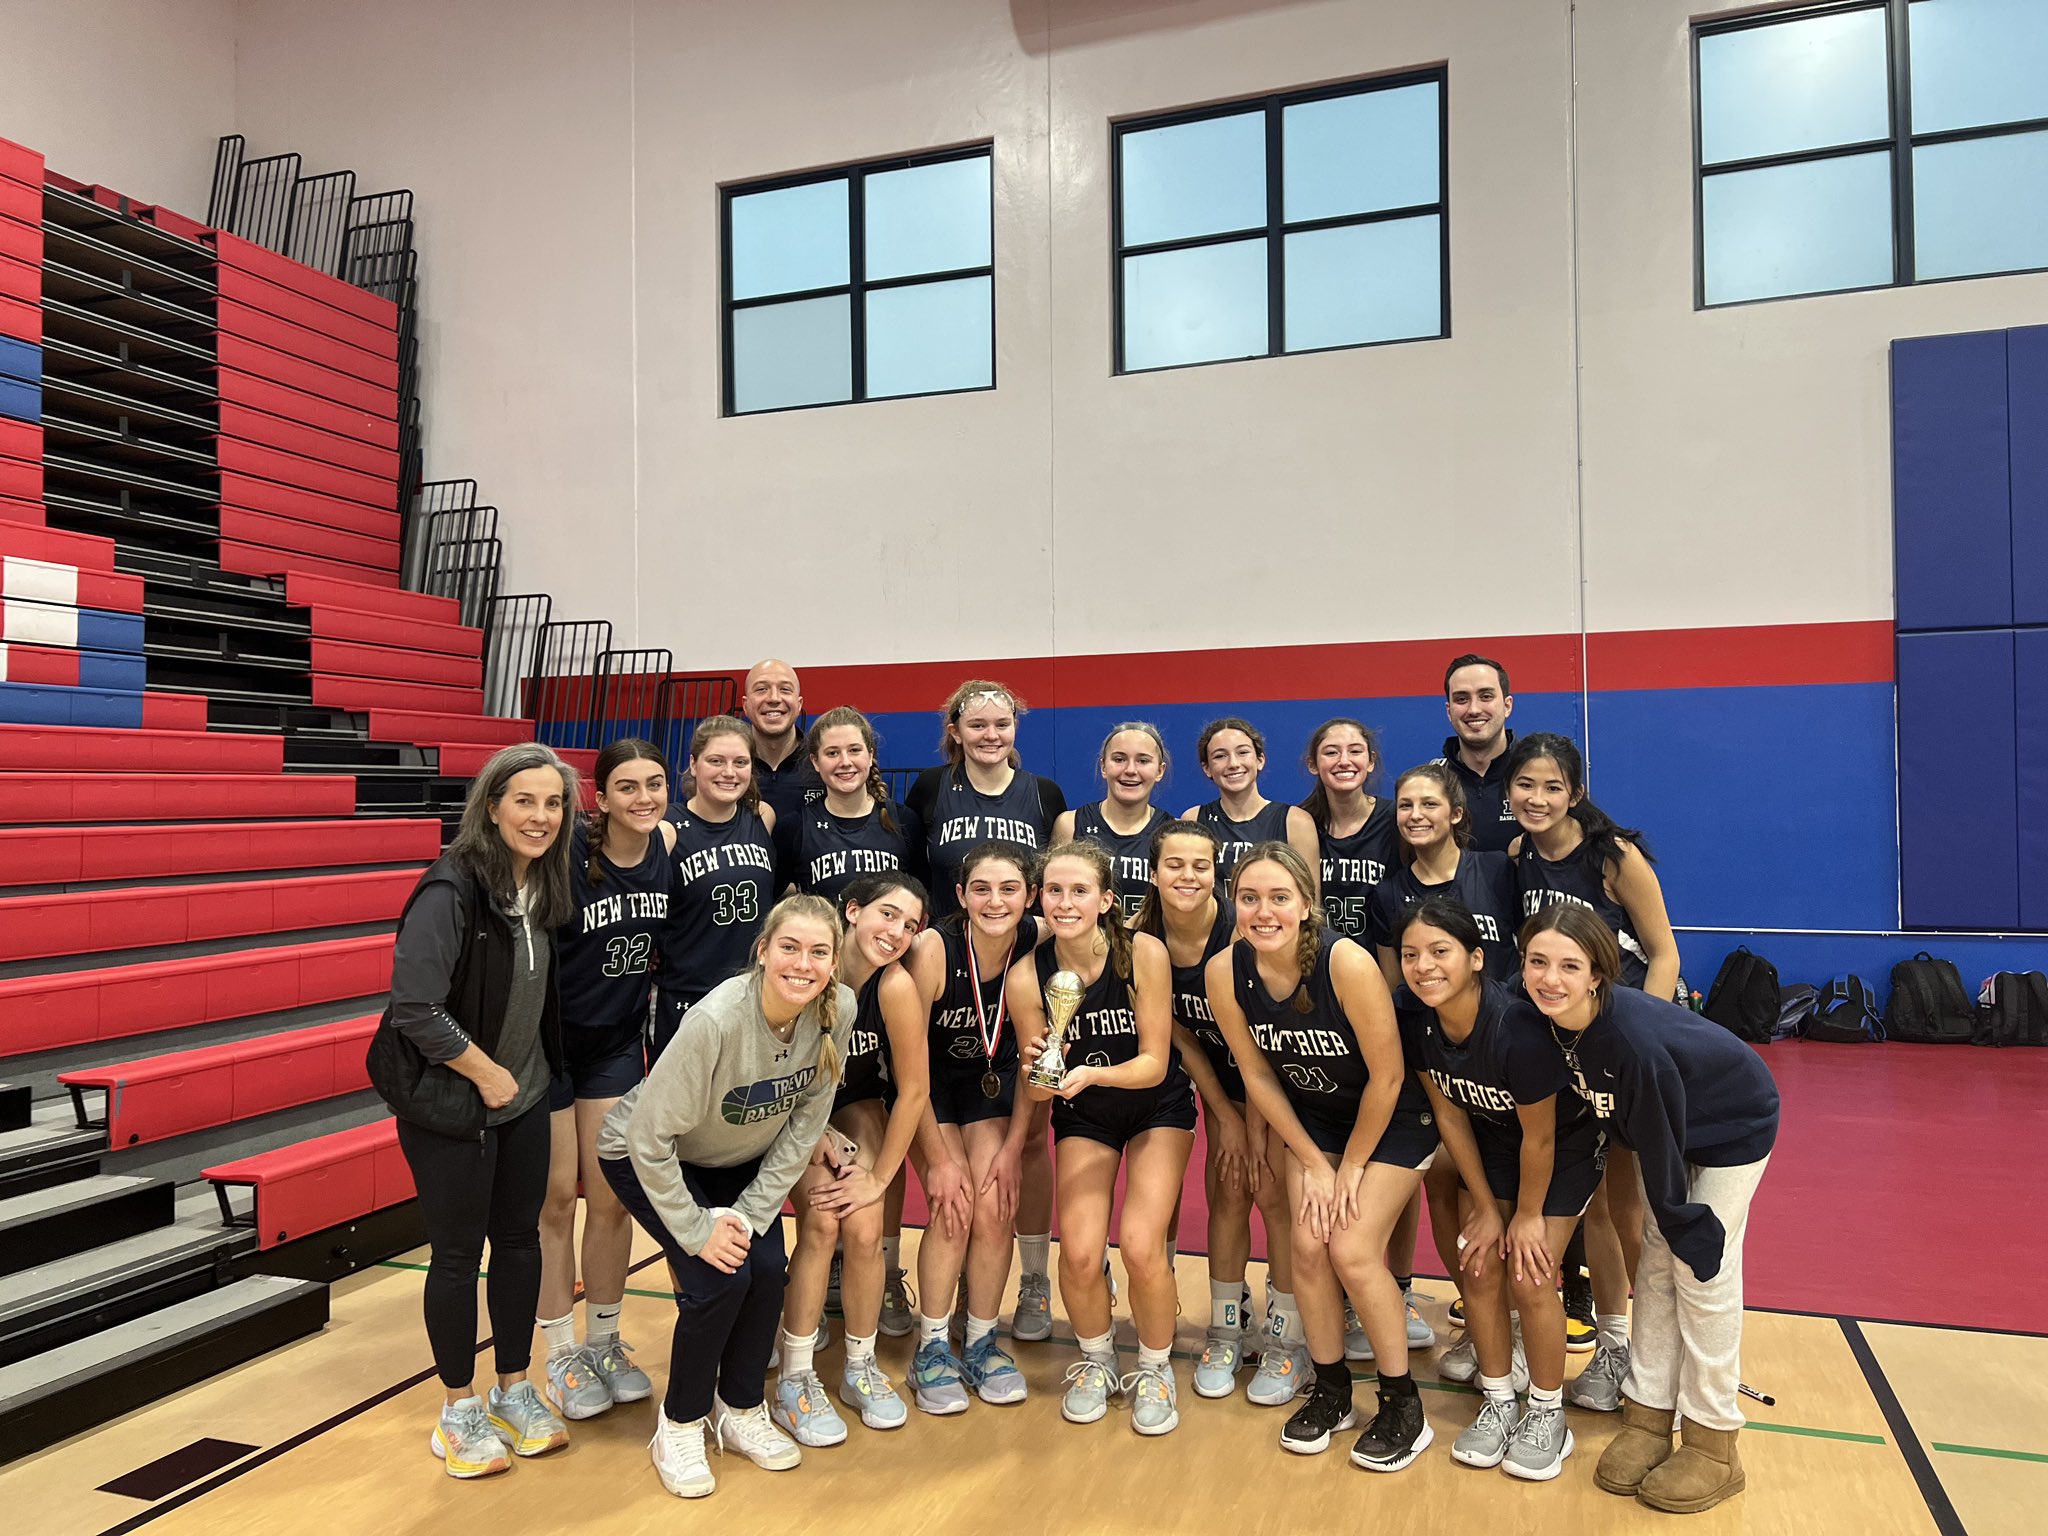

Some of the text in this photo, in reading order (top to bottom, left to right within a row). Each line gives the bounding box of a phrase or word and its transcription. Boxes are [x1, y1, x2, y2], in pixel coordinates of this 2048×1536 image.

[939, 816, 1038, 849] NEW TRIER
[679, 843, 772, 887] NEW TRIER
[810, 850, 847, 885] NEW
[1120, 855, 1153, 883] TRI
[582, 894, 622, 934] NEW
[711, 879, 759, 926] 33
[1323, 895, 1367, 937] 25
[1522, 888, 1544, 918] EW
[601, 932, 652, 977] 32
[936, 1006, 980, 1029] NEW
[1181, 992, 1215, 1022] TRI
[847, 1030, 879, 1057] IER
[1280, 1029, 1350, 1057] TRIER
[1281, 1063, 1339, 1094] 21
[1452, 1077, 1516, 1111] TRIER
